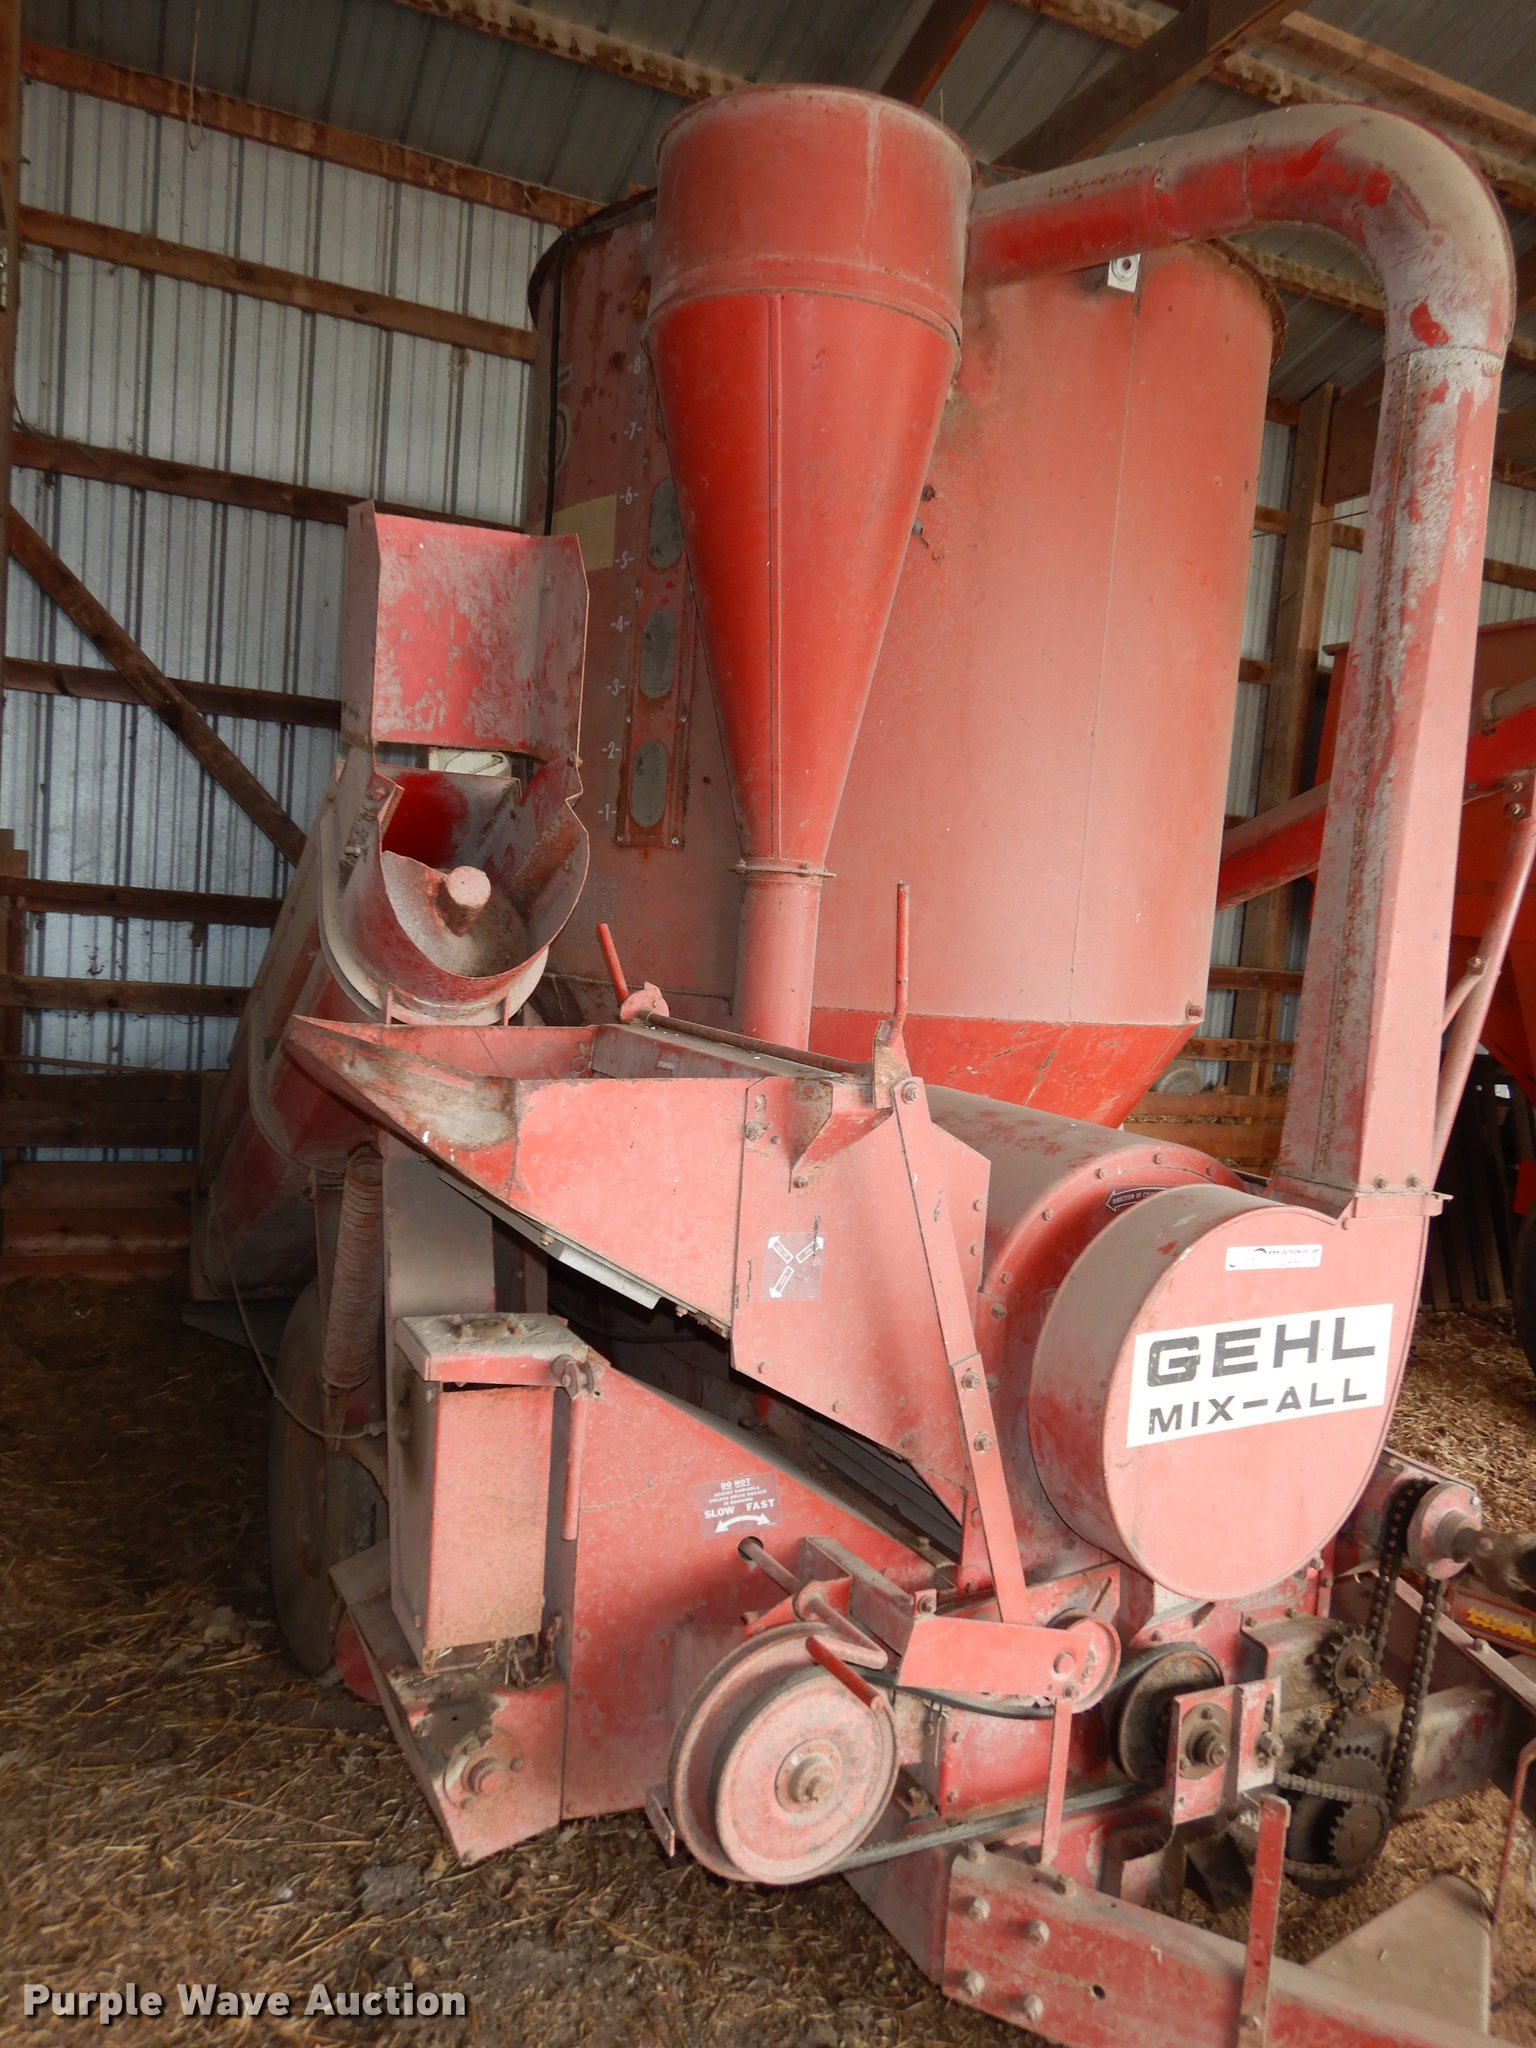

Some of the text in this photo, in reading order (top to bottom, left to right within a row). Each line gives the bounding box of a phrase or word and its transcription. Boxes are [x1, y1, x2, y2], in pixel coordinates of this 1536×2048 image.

[1147, 1316, 1376, 1387] GEHL
[1148, 1378, 1368, 1435] MIX-ALL
[720, 1478, 751, 1490] DO NOT
[704, 1498, 775, 1519] SLOW FAST
